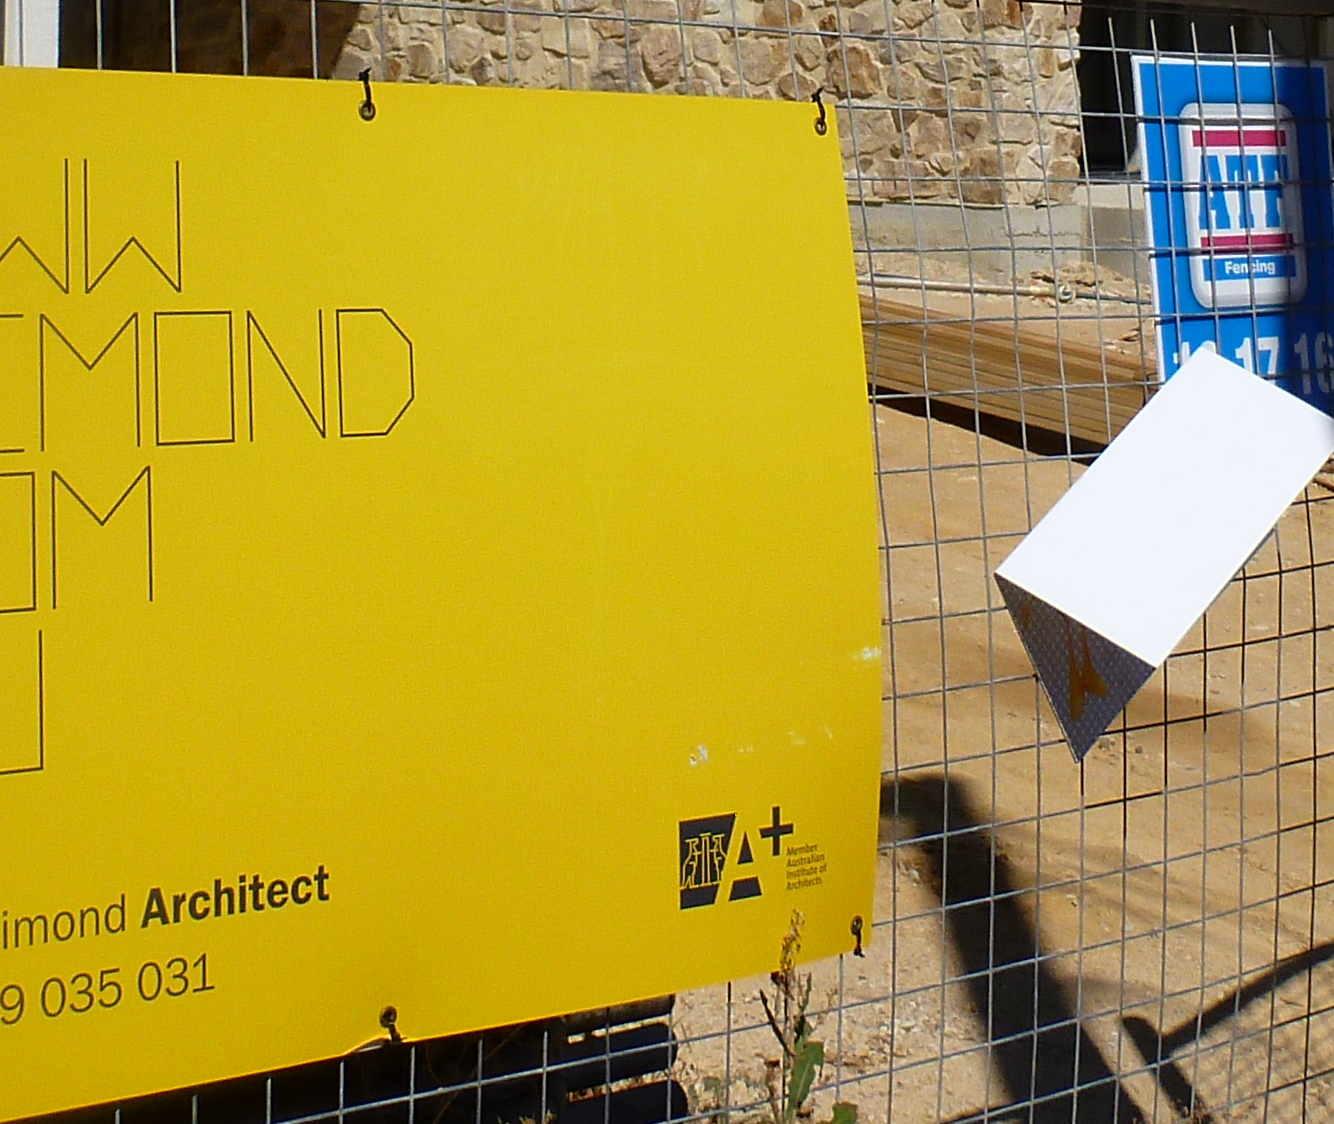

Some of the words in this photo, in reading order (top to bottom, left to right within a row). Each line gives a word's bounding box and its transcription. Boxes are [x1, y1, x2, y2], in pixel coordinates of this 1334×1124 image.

[1225, 259, 1276, 274] Fencing
[786, 843, 817, 856] Member
[786, 853, 825, 867] Australian
[786, 867, 817, 879] Institute
[819, 863, 827, 873] of
[786, 877, 822, 890] Architects
[140, 865, 331, 929] Architect
[40, 967, 124, 1019] 035
[137, 952, 216, 1002] 031
